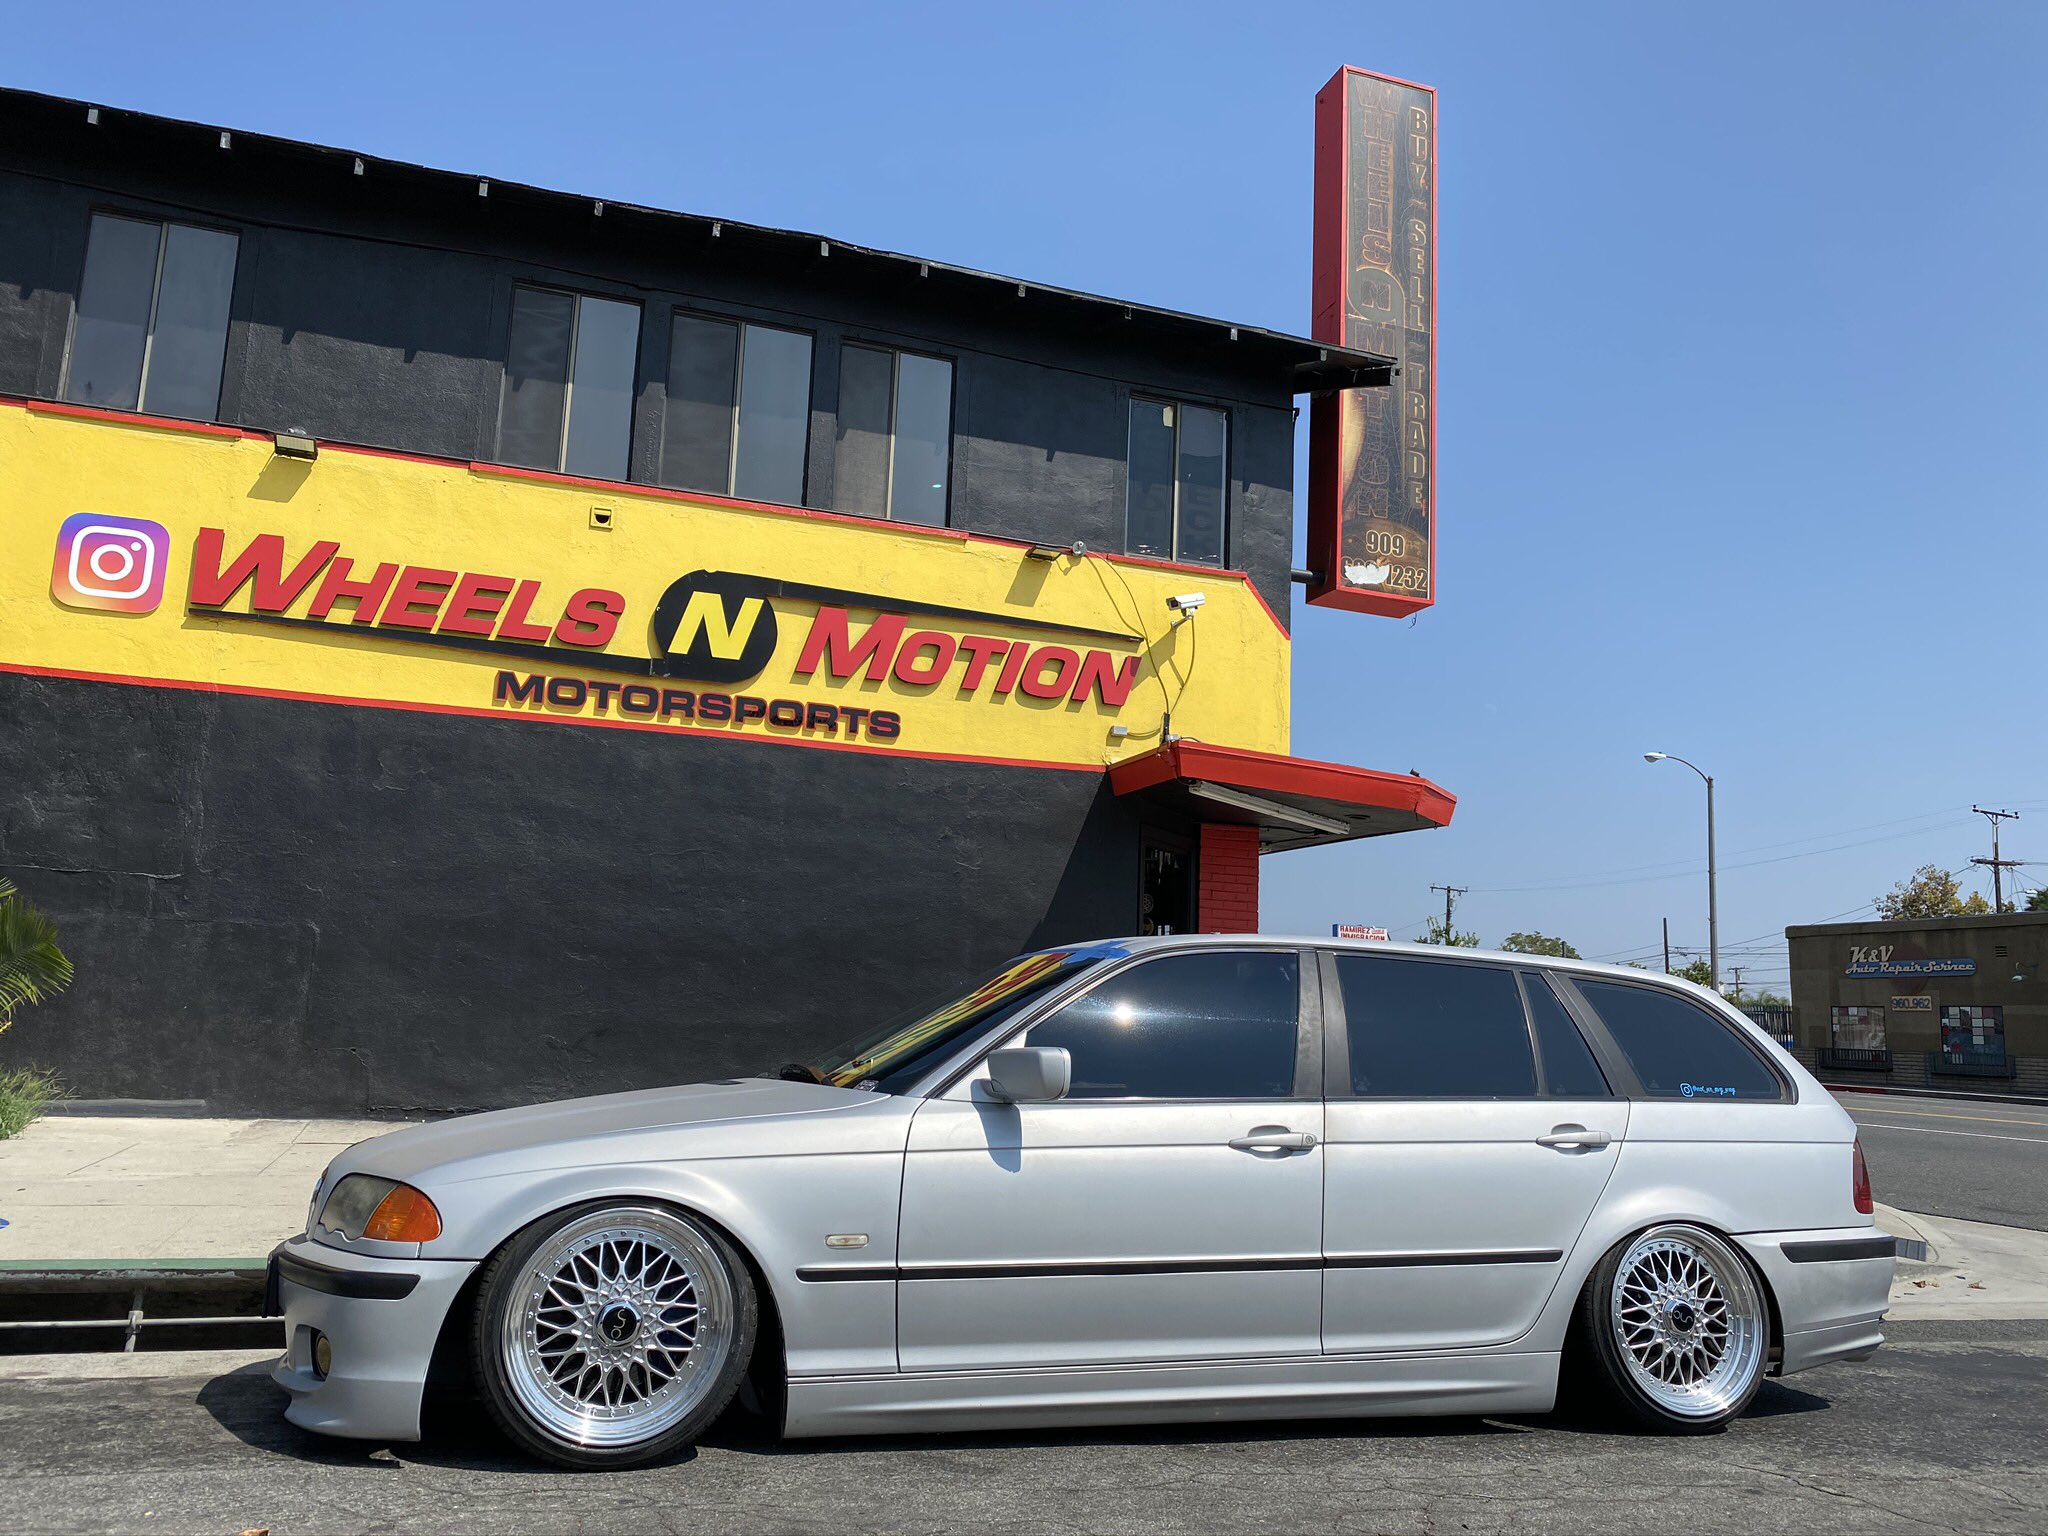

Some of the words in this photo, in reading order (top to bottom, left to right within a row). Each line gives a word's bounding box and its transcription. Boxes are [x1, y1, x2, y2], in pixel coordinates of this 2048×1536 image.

[1356, 76, 1401, 266] WHEELS
[1408, 106, 1428, 197] BUY
[1408, 219, 1427, 332] SELL
[1407, 362, 1426, 509] TRADE
[1366, 529, 1405, 558] 909
[190, 526, 626, 647] WHEELS
[668, 591, 766, 661] N
[795, 606, 1142, 706] MOTION
[495, 669, 901, 739] MOTORSPORTS
[1340, 925, 1371, 935] RAMIREZ
[1845, 963, 1879, 975] Auto
[1879, 961, 1922, 975] Repair
[1850, 945, 1894, 963] K&V
